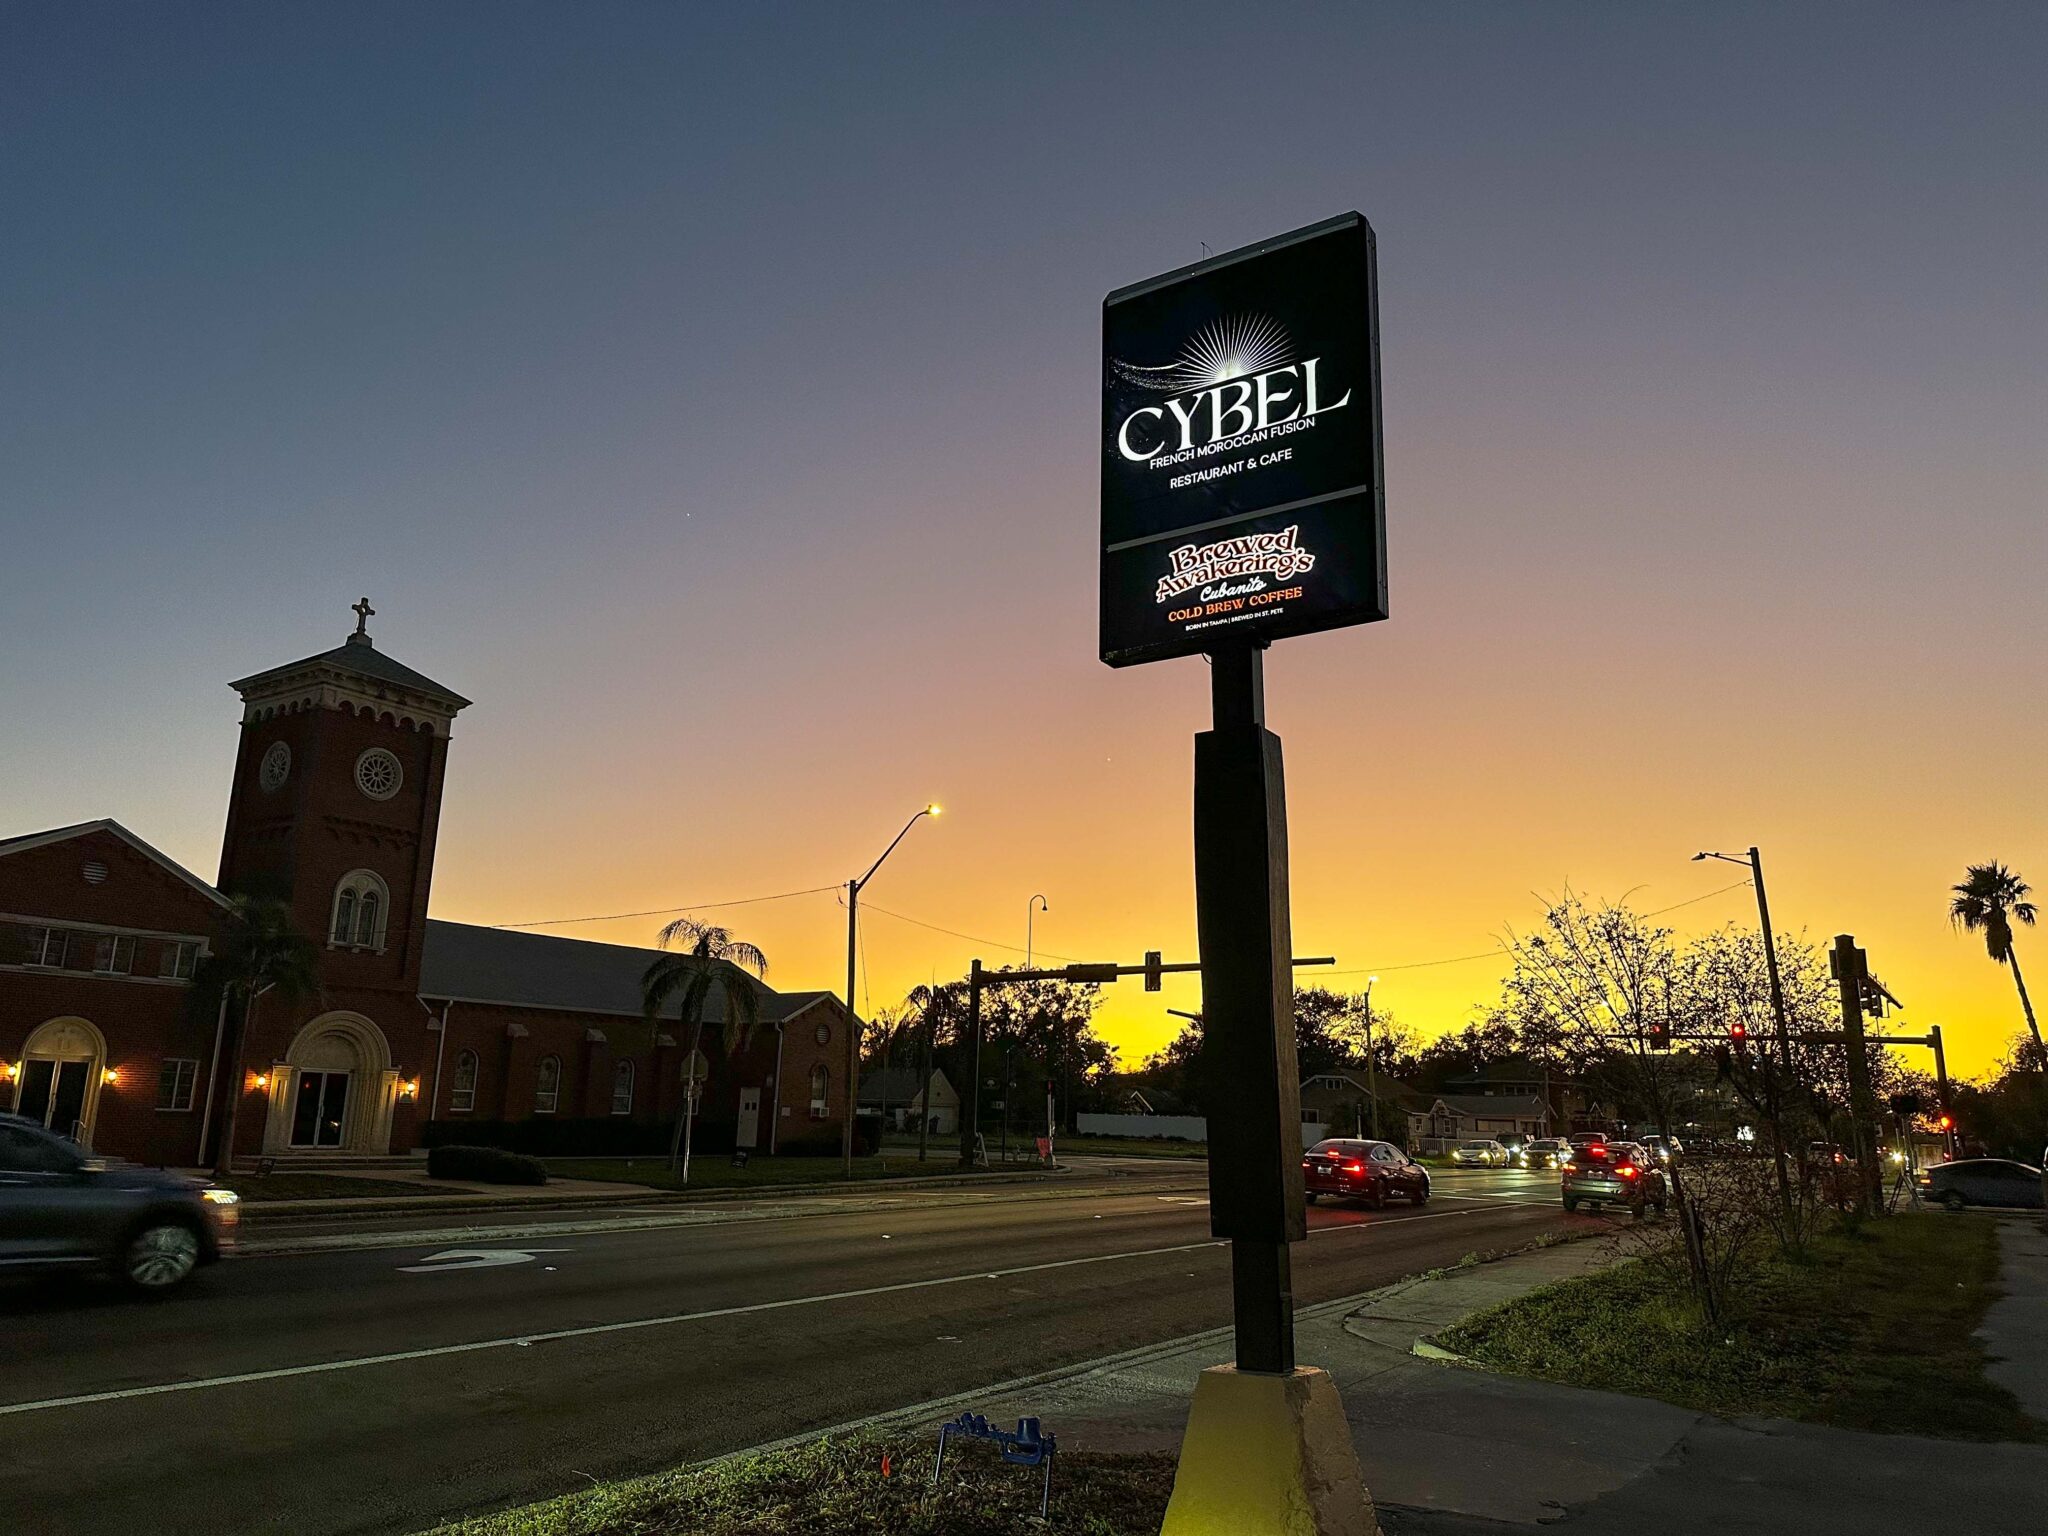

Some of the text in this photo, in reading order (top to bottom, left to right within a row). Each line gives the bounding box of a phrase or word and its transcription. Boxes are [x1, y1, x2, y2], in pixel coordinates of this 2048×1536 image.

[1118, 357, 1351, 461] CYBEL
[1150, 416, 1316, 470] FRENCH MOROCCAN FUSION
[1170, 448, 1293, 489] RESTAURANT & CAFE
[1169, 525, 1298, 576] Brewed
[1168, 586, 1303, 622] COLD BREW COFFEE
[1200, 575, 1268, 602] Cubanito
[1185, 623, 1201, 631] BORN
[1209, 618, 1228, 627] TAMPA
[1231, 613, 1254, 622] BREWED
[1270, 607, 1284, 615] PETE
